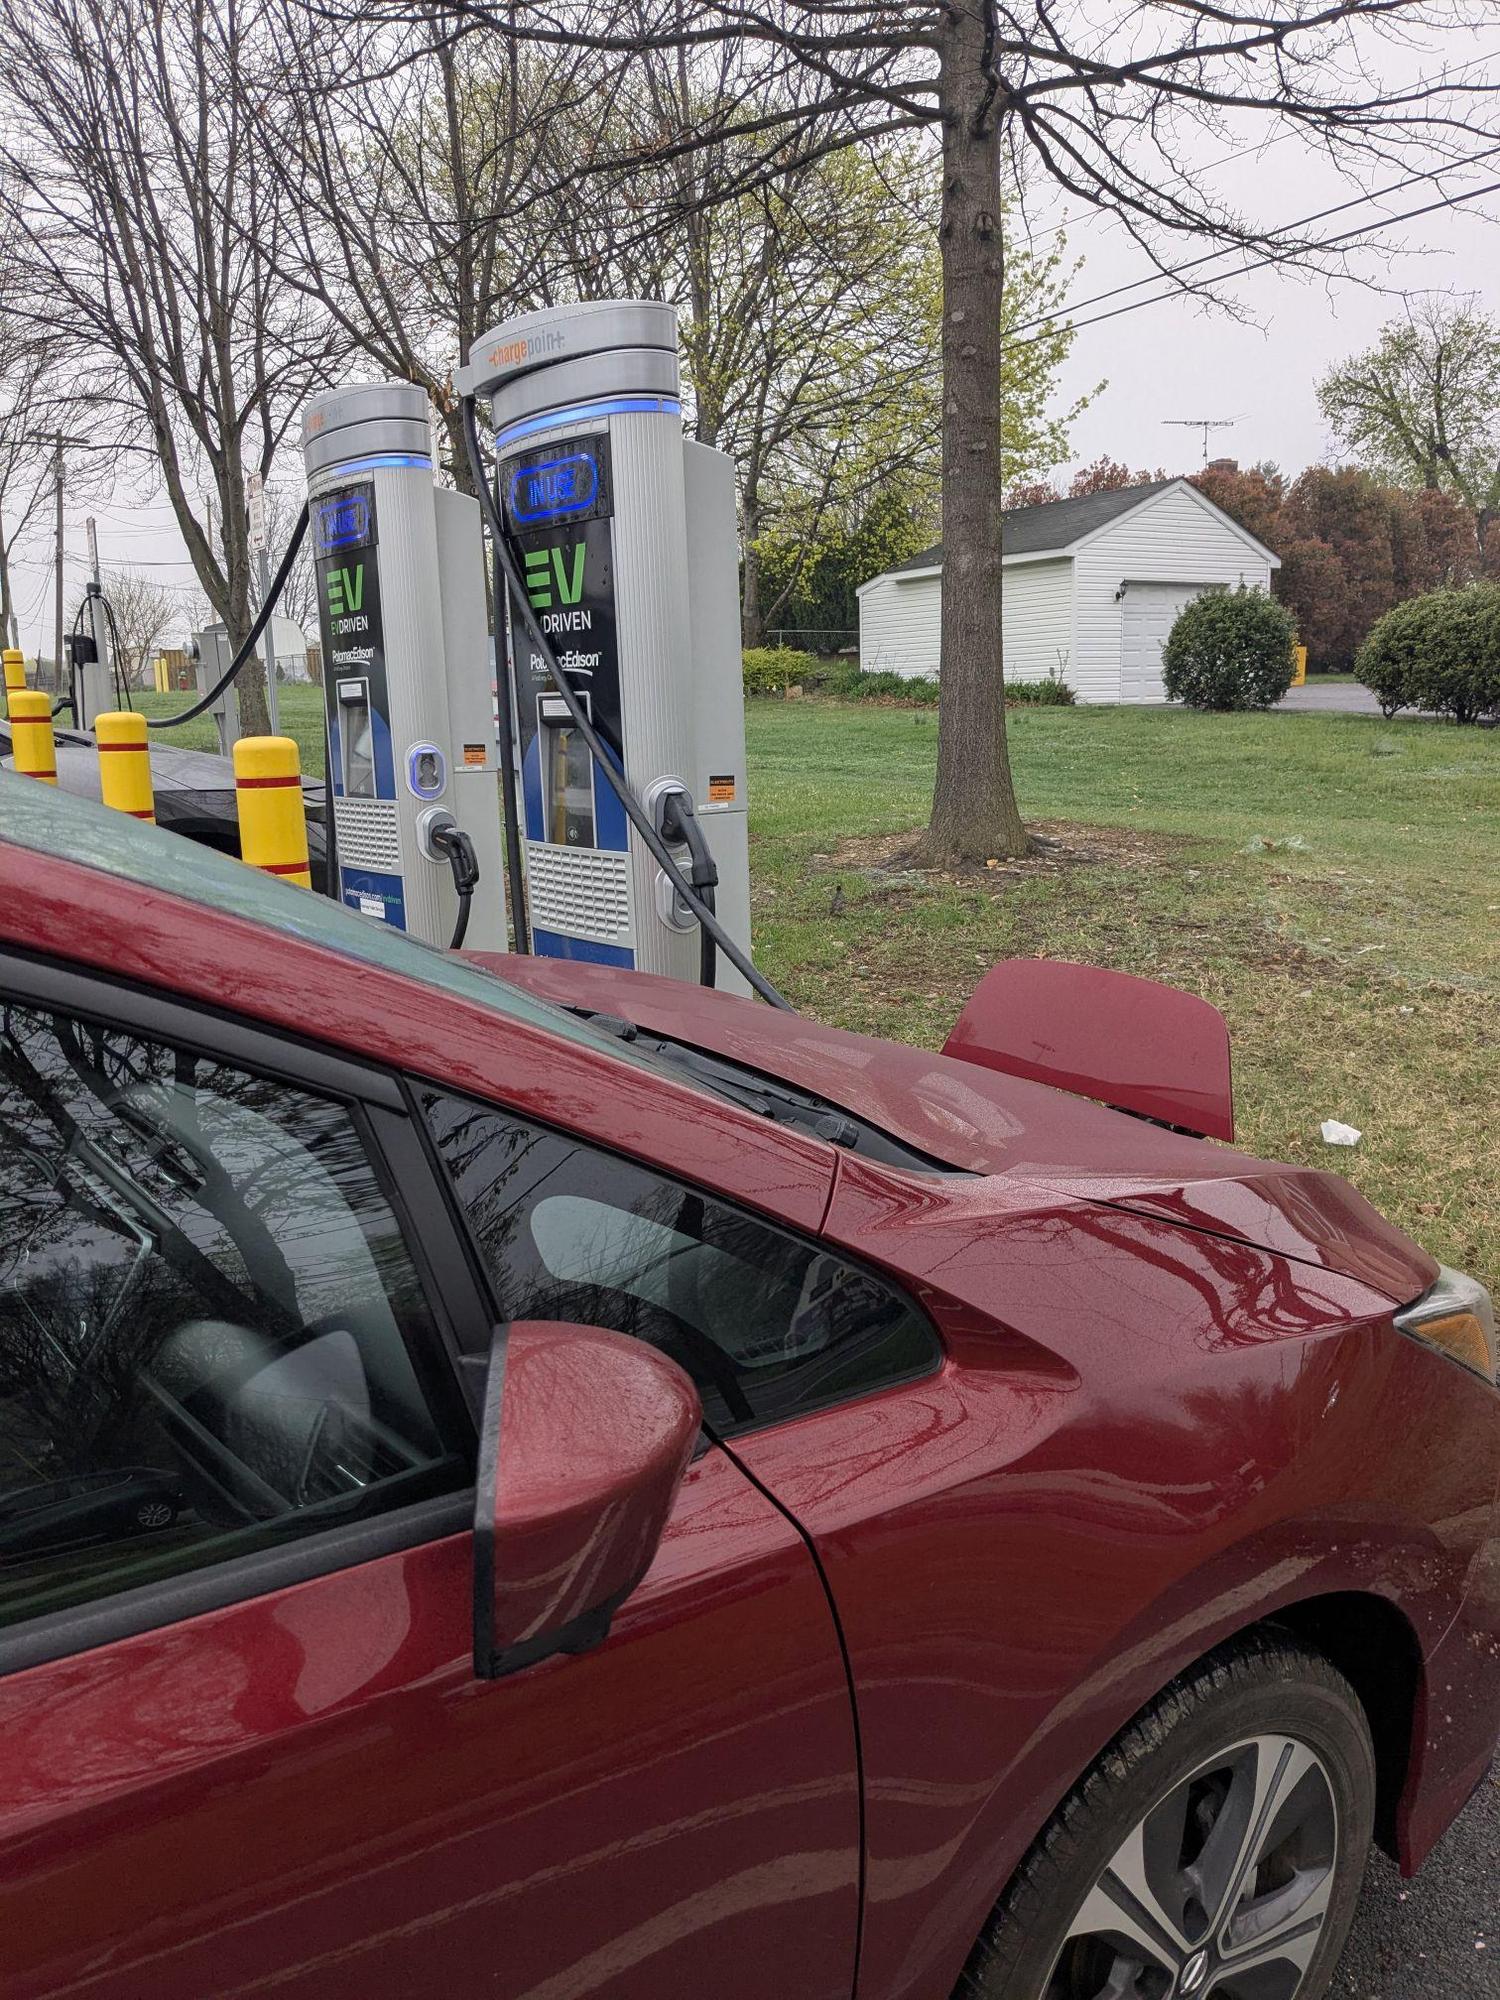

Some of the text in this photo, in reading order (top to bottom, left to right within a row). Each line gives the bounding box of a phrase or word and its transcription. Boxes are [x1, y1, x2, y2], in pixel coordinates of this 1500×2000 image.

[327, 564, 363, 615] EV
[525, 542, 586, 608] EV
[525, 610, 592, 634] DRIVEN
